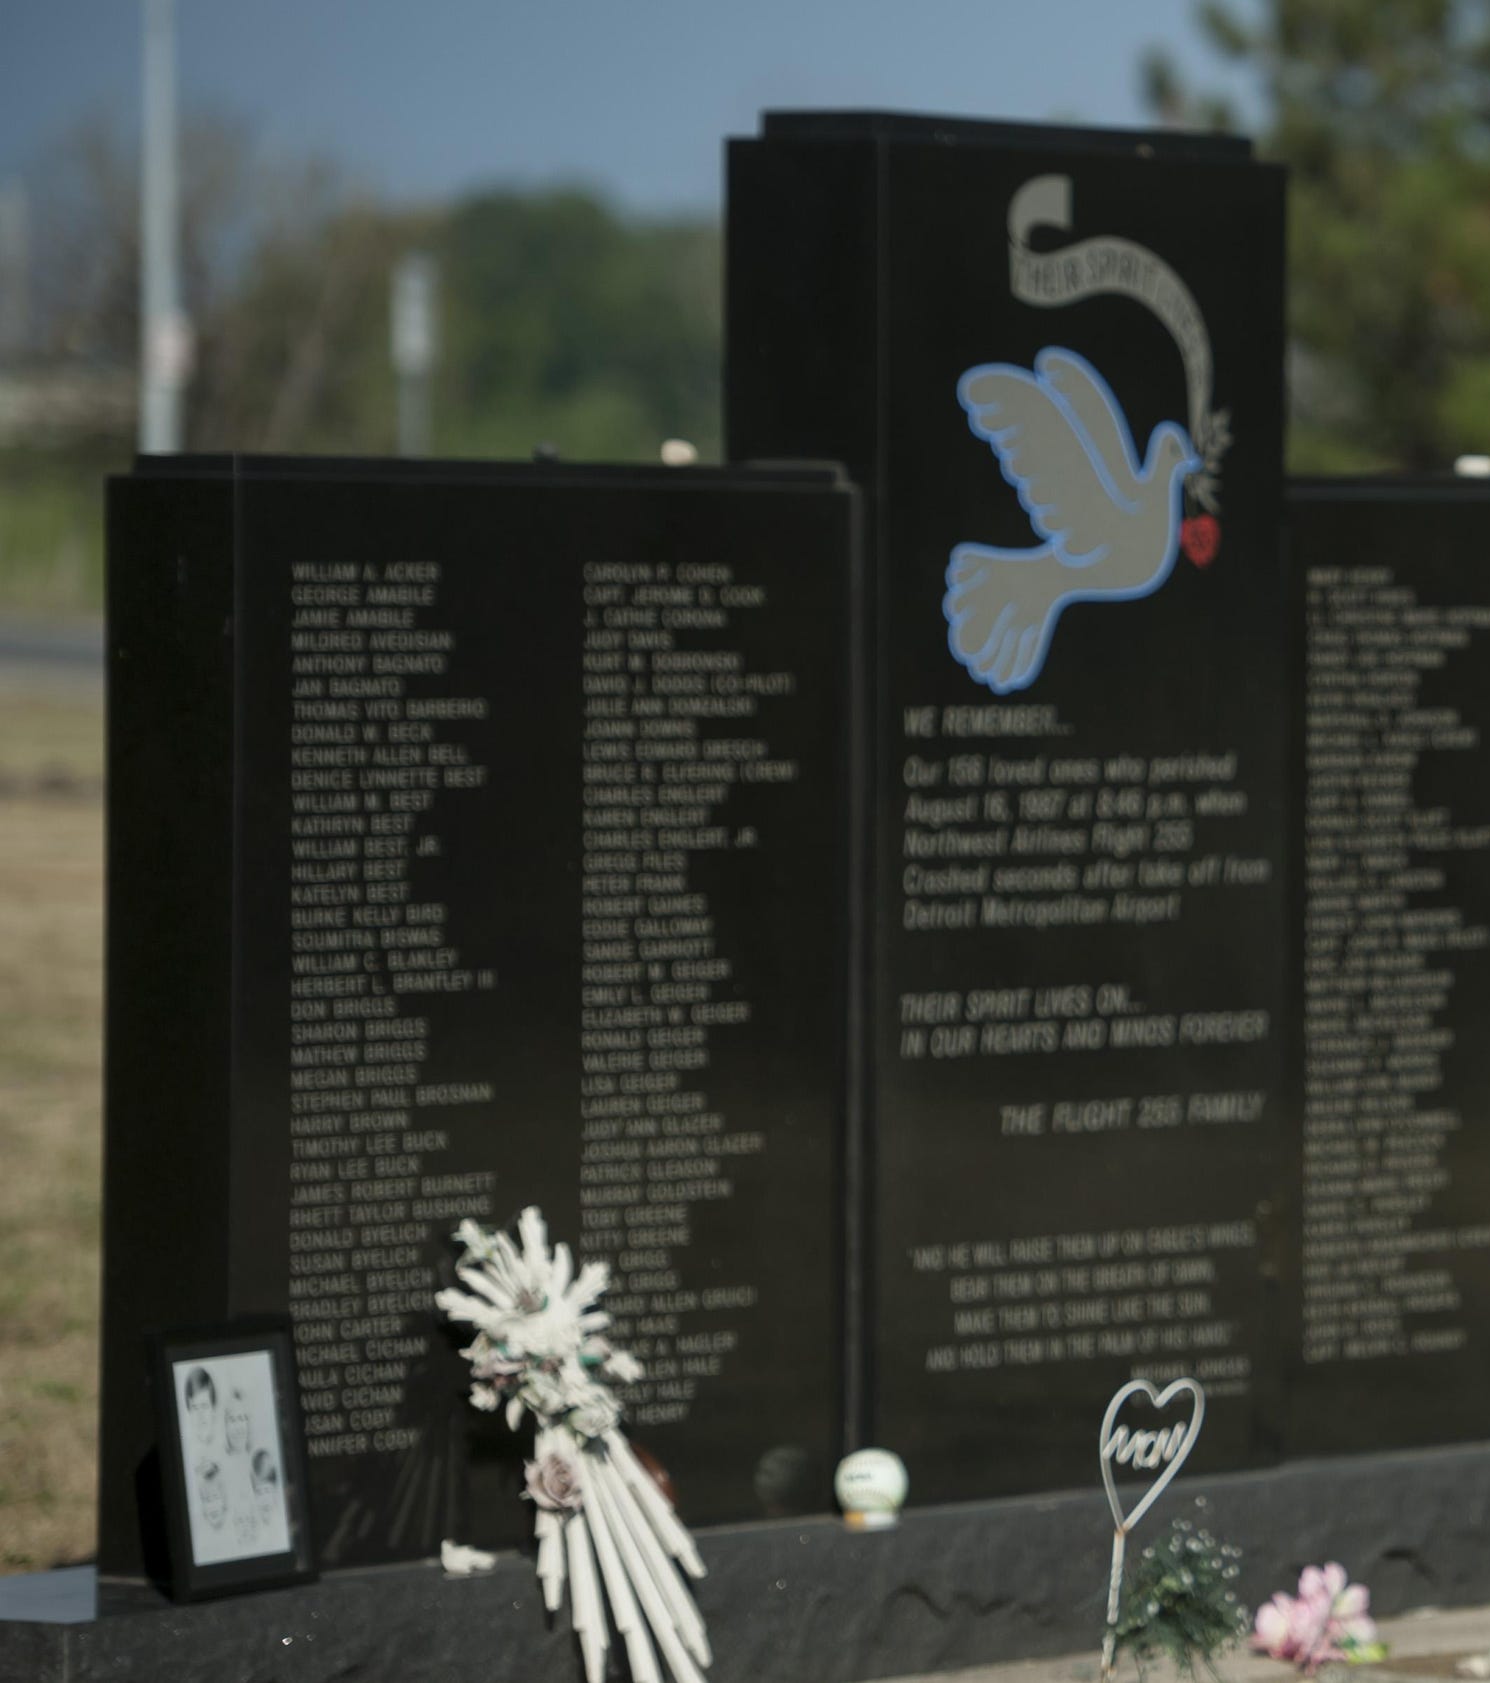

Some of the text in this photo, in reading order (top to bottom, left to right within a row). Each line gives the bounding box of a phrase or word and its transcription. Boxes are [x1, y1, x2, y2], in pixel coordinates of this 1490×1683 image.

[292, 562, 359, 582] WILLIAM
[384, 562, 440, 582] ACKER
[292, 585, 362, 605] GEORGE
[292, 608, 415, 628] JAMIE AMABILE
[292, 631, 365, 651] MILDRED
[293, 655, 368, 674] ANTHONY
[292, 678, 325, 697] JAN
[293, 700, 361, 720] THOMAS
[365, 700, 402, 720] VITO
[292, 724, 358, 744] DONALD
[388, 722, 434, 742] BECK
[905, 706, 940, 738] WE
[291, 744, 469, 766] KENNETH ALLEN BELL
[444, 766, 486, 787] BEST
[904, 755, 945, 788] Our
[989, 754, 1047, 785] loved
[1050, 759, 1101, 784] ones
[1105, 753, 1147, 782] who
[1150, 750, 1238, 788] perished
[292, 792, 360, 813] WILLIAM
[389, 790, 433, 811] BEST
[905, 793, 979, 829] August
[1069, 790, 1094, 820] at
[1196, 786, 1248, 816] when
[292, 813, 414, 835] KATHRYN BEST
[292, 838, 359, 859] WILLIAM
[904, 827, 1009, 858] Northwest
[1011, 824, 1089, 854] Airlines
[1093, 821, 1152, 859] Flight
[292, 859, 407, 882] HILLARY BEST
[904, 855, 1272, 895] Crashed seconds after take off from
[292, 882, 410, 905] KATELYN BEST
[353, 906, 401, 926] KELLY
[904, 892, 1181, 930] Detroit Metropolitan Airport
[292, 953, 359, 974] WILLIAM
[292, 974, 367, 997] HERBERT
[291, 996, 397, 1021] DON BRIGGS
[900, 991, 963, 1024] THEIR
[966, 987, 1033, 1022] SPIRIT
[1035, 985, 1094, 1018] LIVES
[291, 1018, 429, 1044] SHARON BRIGGS
[901, 1010, 1270, 1059] IN OUR HEARTS AND MINDS FOREVER
[364, 1041, 427, 1063] BRIGGS
[291, 1064, 419, 1089] MEGAN BRIGGS
[291, 1091, 367, 1113] STEPHEN
[370, 1088, 412, 1107] PAUL
[1001, 1103, 1048, 1133] THE
[1053, 1098, 1135, 1133] FLIGHT
[1189, 1091, 1266, 1124] FAMILY
[349, 1111, 411, 1132] BROWN
[293, 1130, 448, 1157] TIMOTHY LEE BUCK
[338, 1160, 369, 1179] LEE
[375, 1155, 422, 1177] BUCK
[291, 1183, 347, 1205] JAMES
[351, 1178, 417, 1201] ROBERT
[347, 1202, 408, 1224] TAYLOR
[290, 1228, 356, 1251] DONALD
[290, 1252, 347, 1274] SUSAN
[289, 1274, 362, 1297] MICHAEL
[341, 1317, 404, 1340] CARTER
[299, 1367, 341, 1389] AULA
